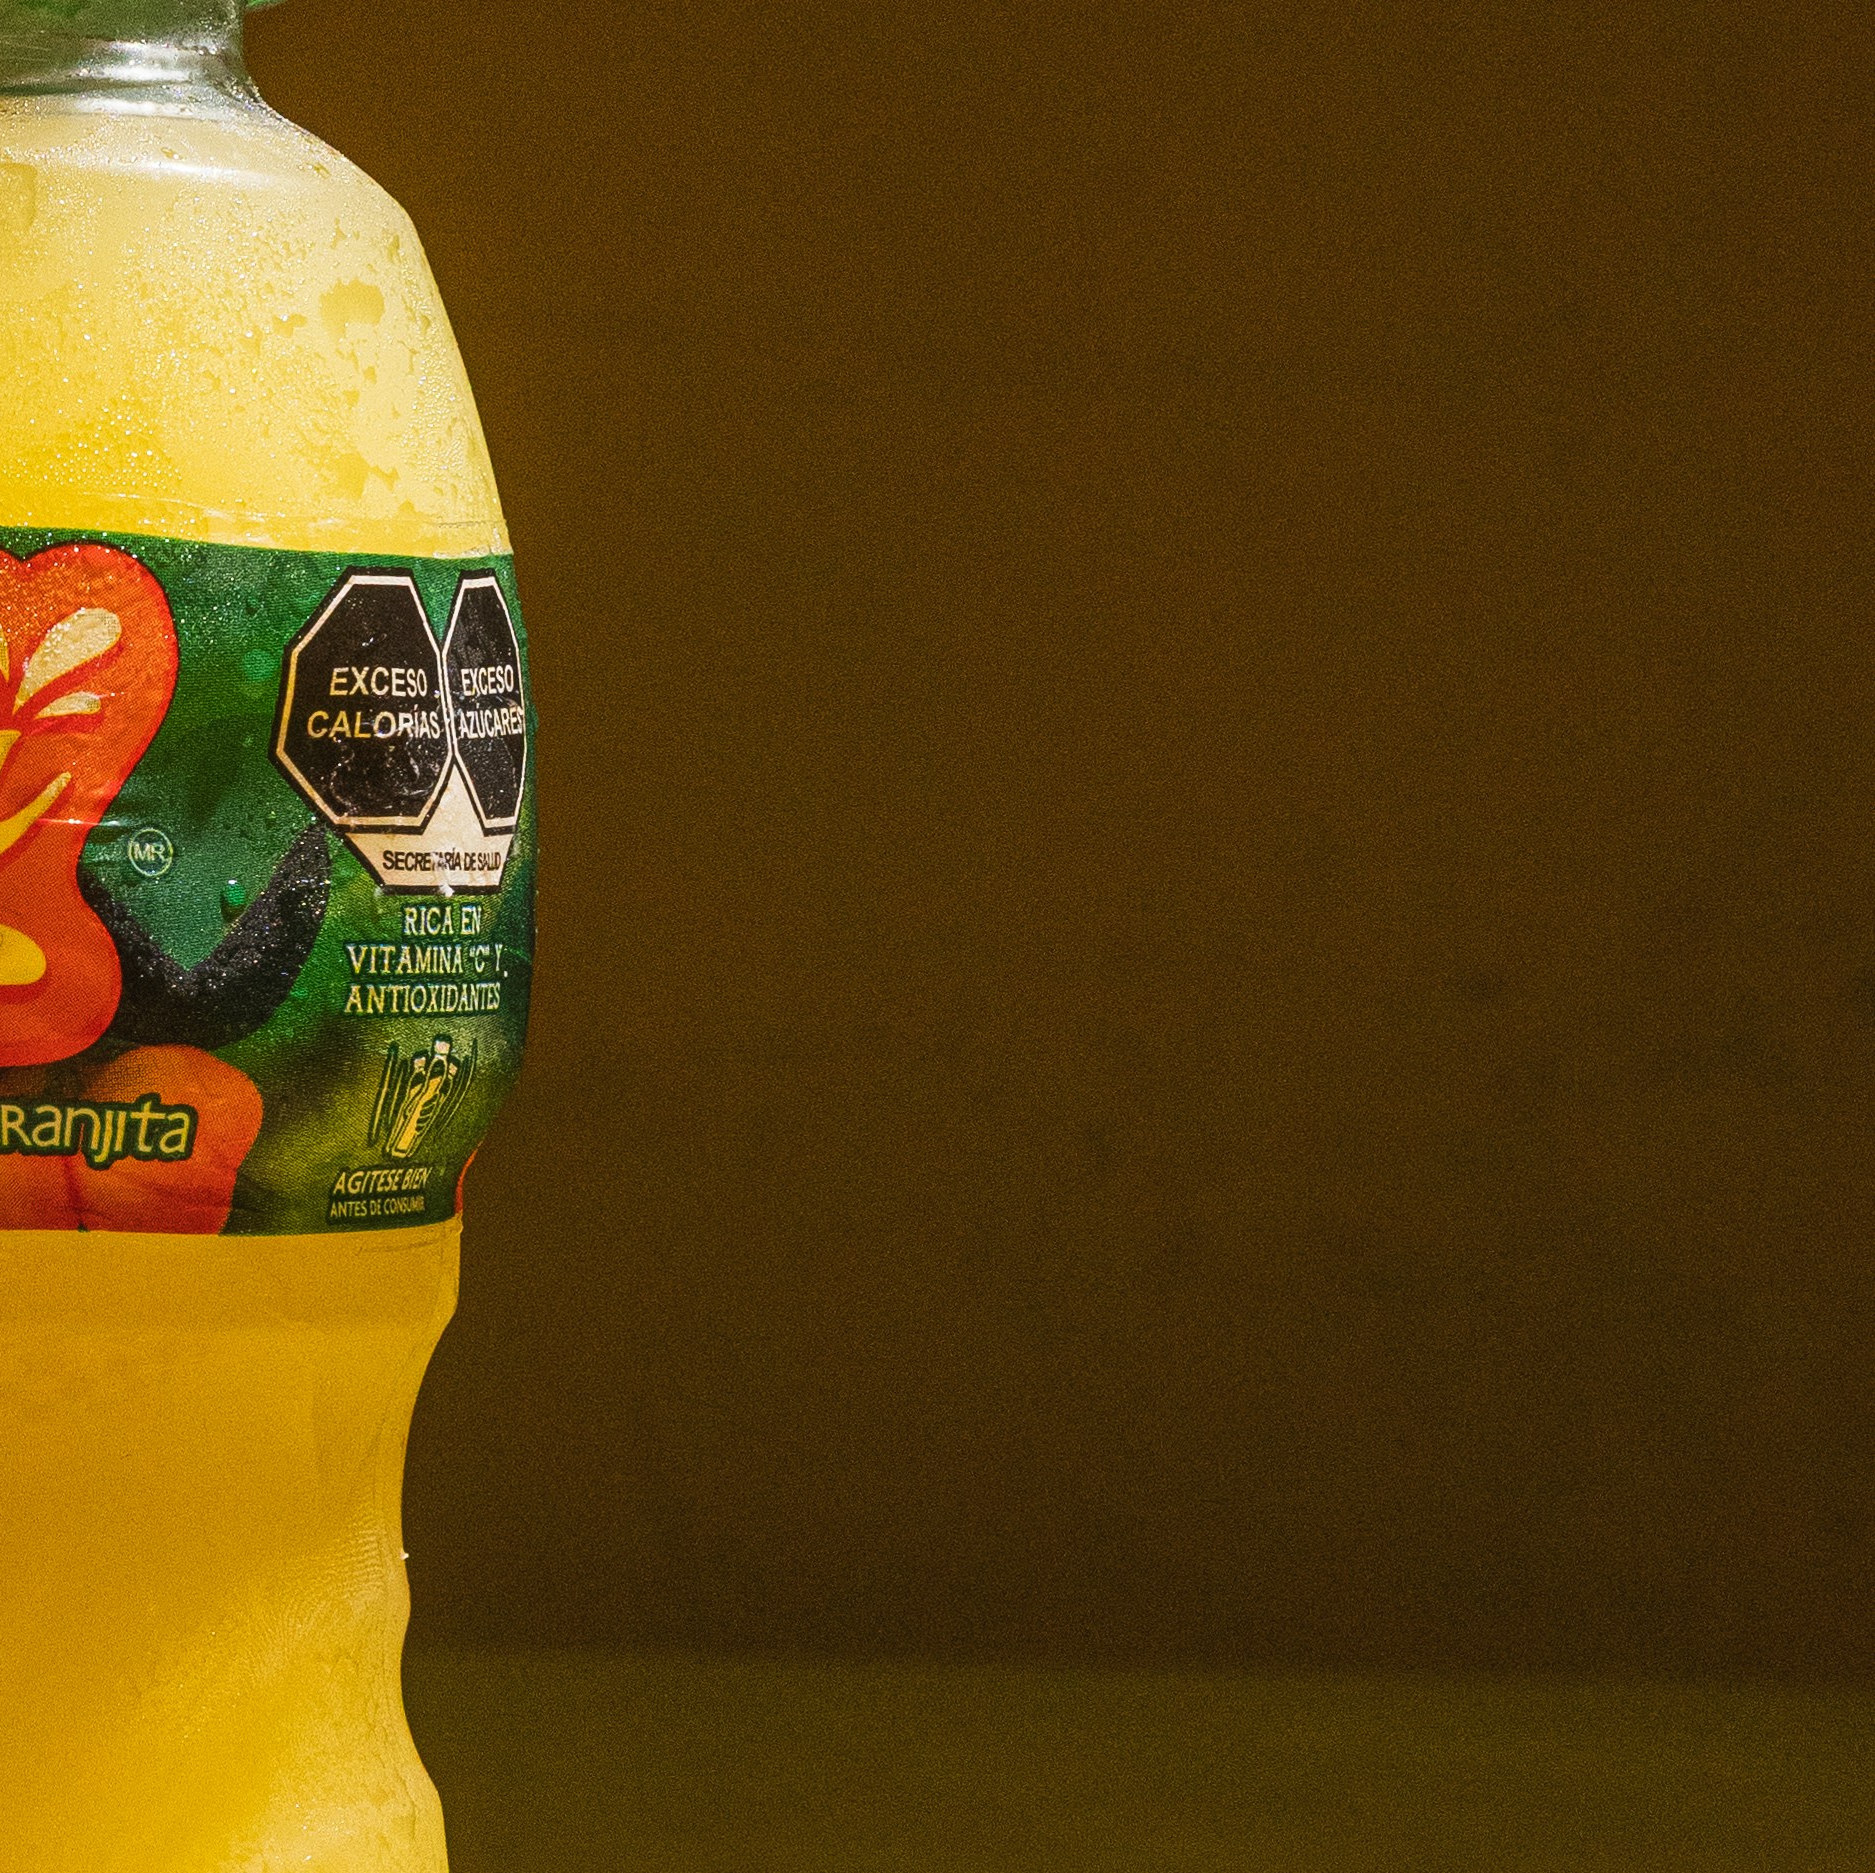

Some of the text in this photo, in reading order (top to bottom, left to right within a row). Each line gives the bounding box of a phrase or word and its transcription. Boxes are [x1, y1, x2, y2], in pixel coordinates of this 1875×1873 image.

[329, 665, 428, 697] EXCESO
[460, 664, 515, 696] EXCESO
[306, 704, 441, 739] CALORÍAS
[463, 851, 476, 872] DE
[477, 851, 502, 871] SALUD
[403, 905, 482, 936] RICA EN
[345, 943, 464, 975] VITAMINA
[494, 943, 504, 972] Y
[344, 982, 502, 1014] ANTIOXIDANTES
[333, 1167, 432, 1194] AGITESE BIEN
[330, 1200, 367, 1218] ANTES
[369, 1199, 382, 1215] DE
